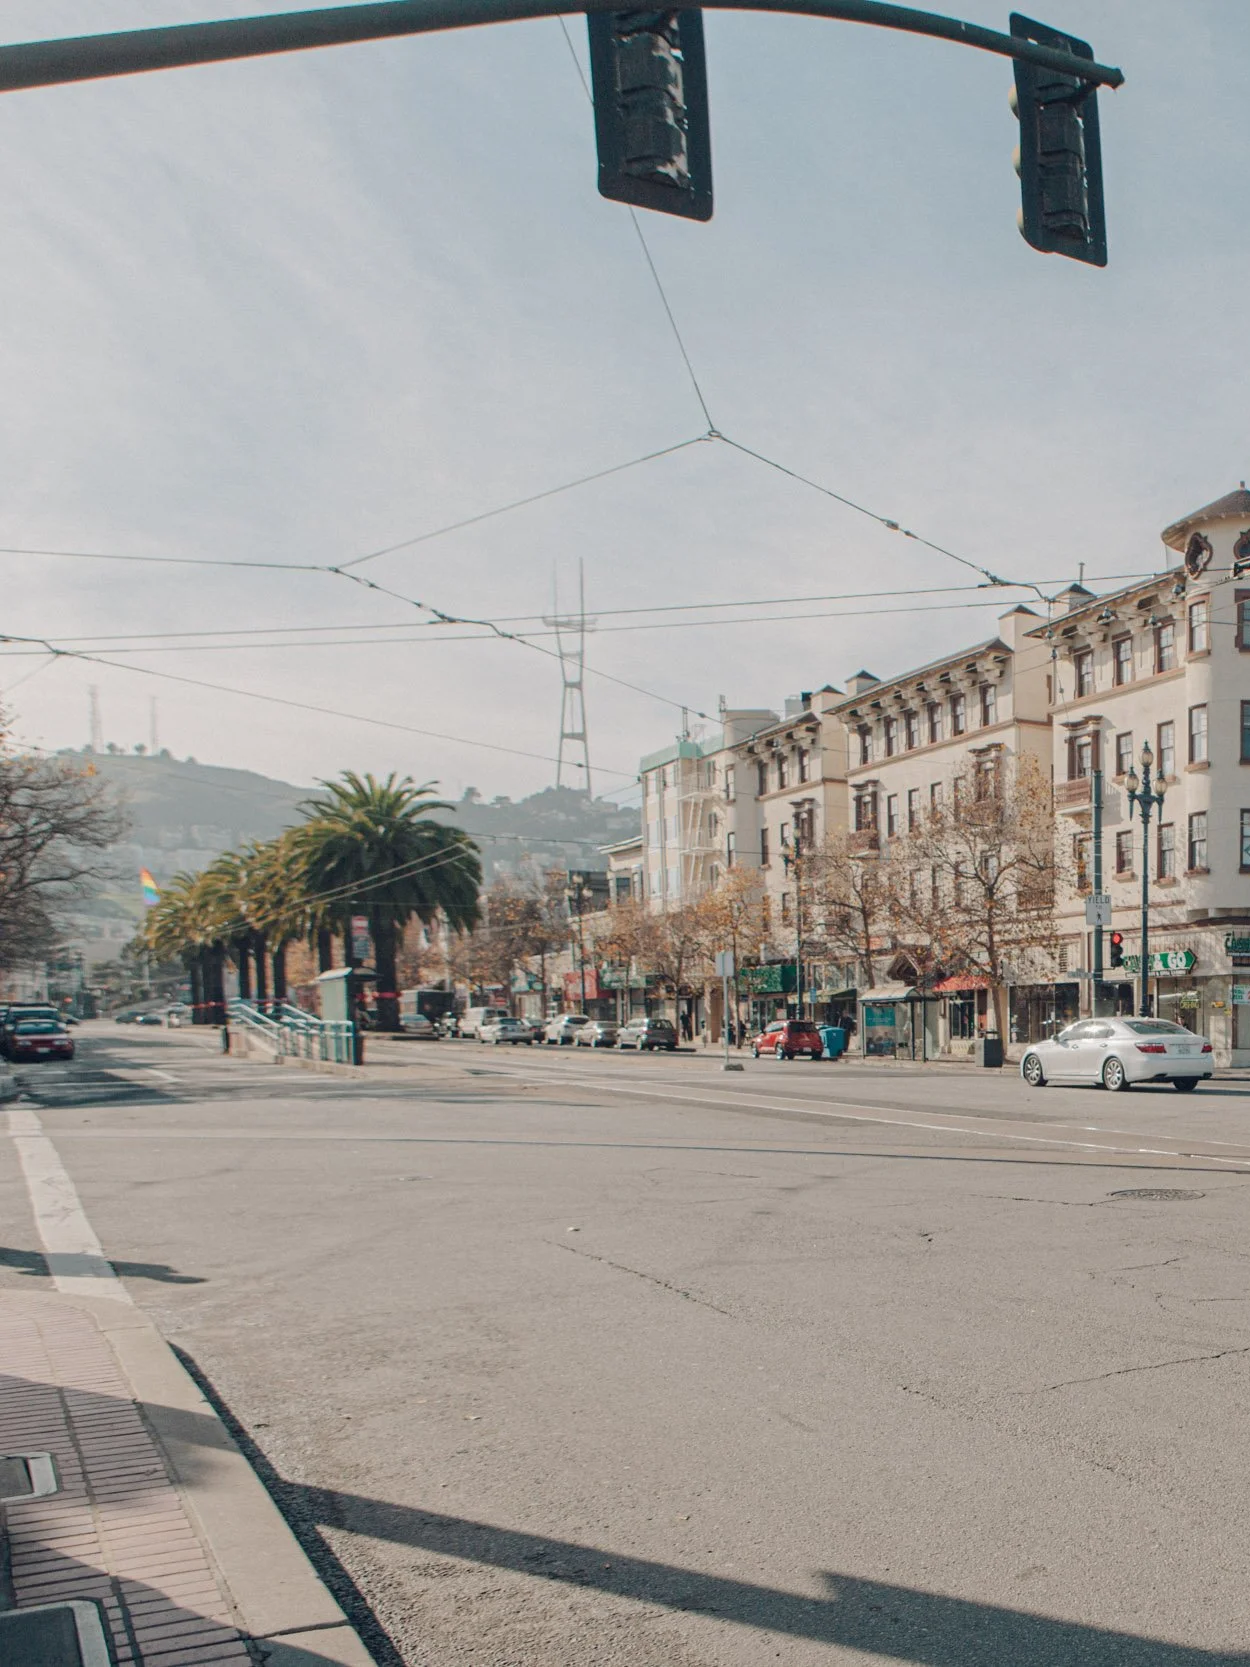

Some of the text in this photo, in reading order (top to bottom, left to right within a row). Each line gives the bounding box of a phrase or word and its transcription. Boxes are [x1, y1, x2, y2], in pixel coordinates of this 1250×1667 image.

[1087, 896, 1110, 904] YIELD
[1154, 954, 1164, 970] &
[1167, 952, 1187, 969] GO
